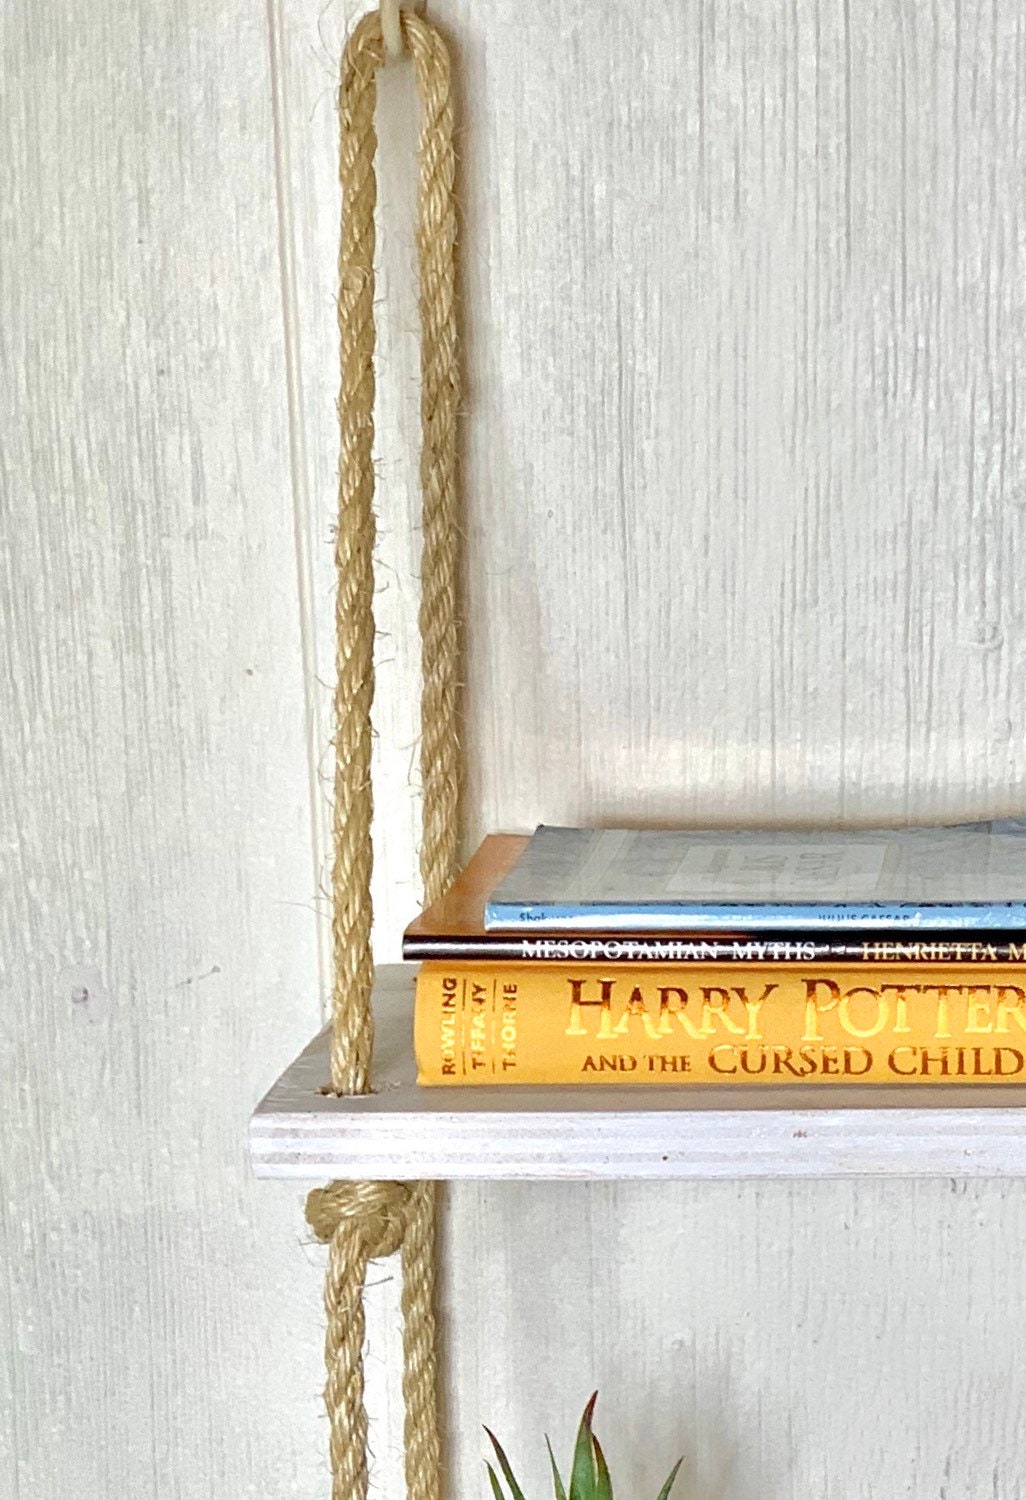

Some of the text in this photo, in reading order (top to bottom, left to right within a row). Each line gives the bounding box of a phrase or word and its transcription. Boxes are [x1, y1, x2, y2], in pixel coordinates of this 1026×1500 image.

[521, 940, 816, 960] MESOPOTAMIAN MYTHS
[862, 941, 998, 961] HENRIETTA
[441, 977, 457, 1075] ROWLING
[471, 983, 486, 1070] TIFFANY
[501, 984, 518, 1071] THORNE
[565, 977, 779, 1039] HARRY
[581, 1044, 1024, 1077] AND THE CURSED CHILD
